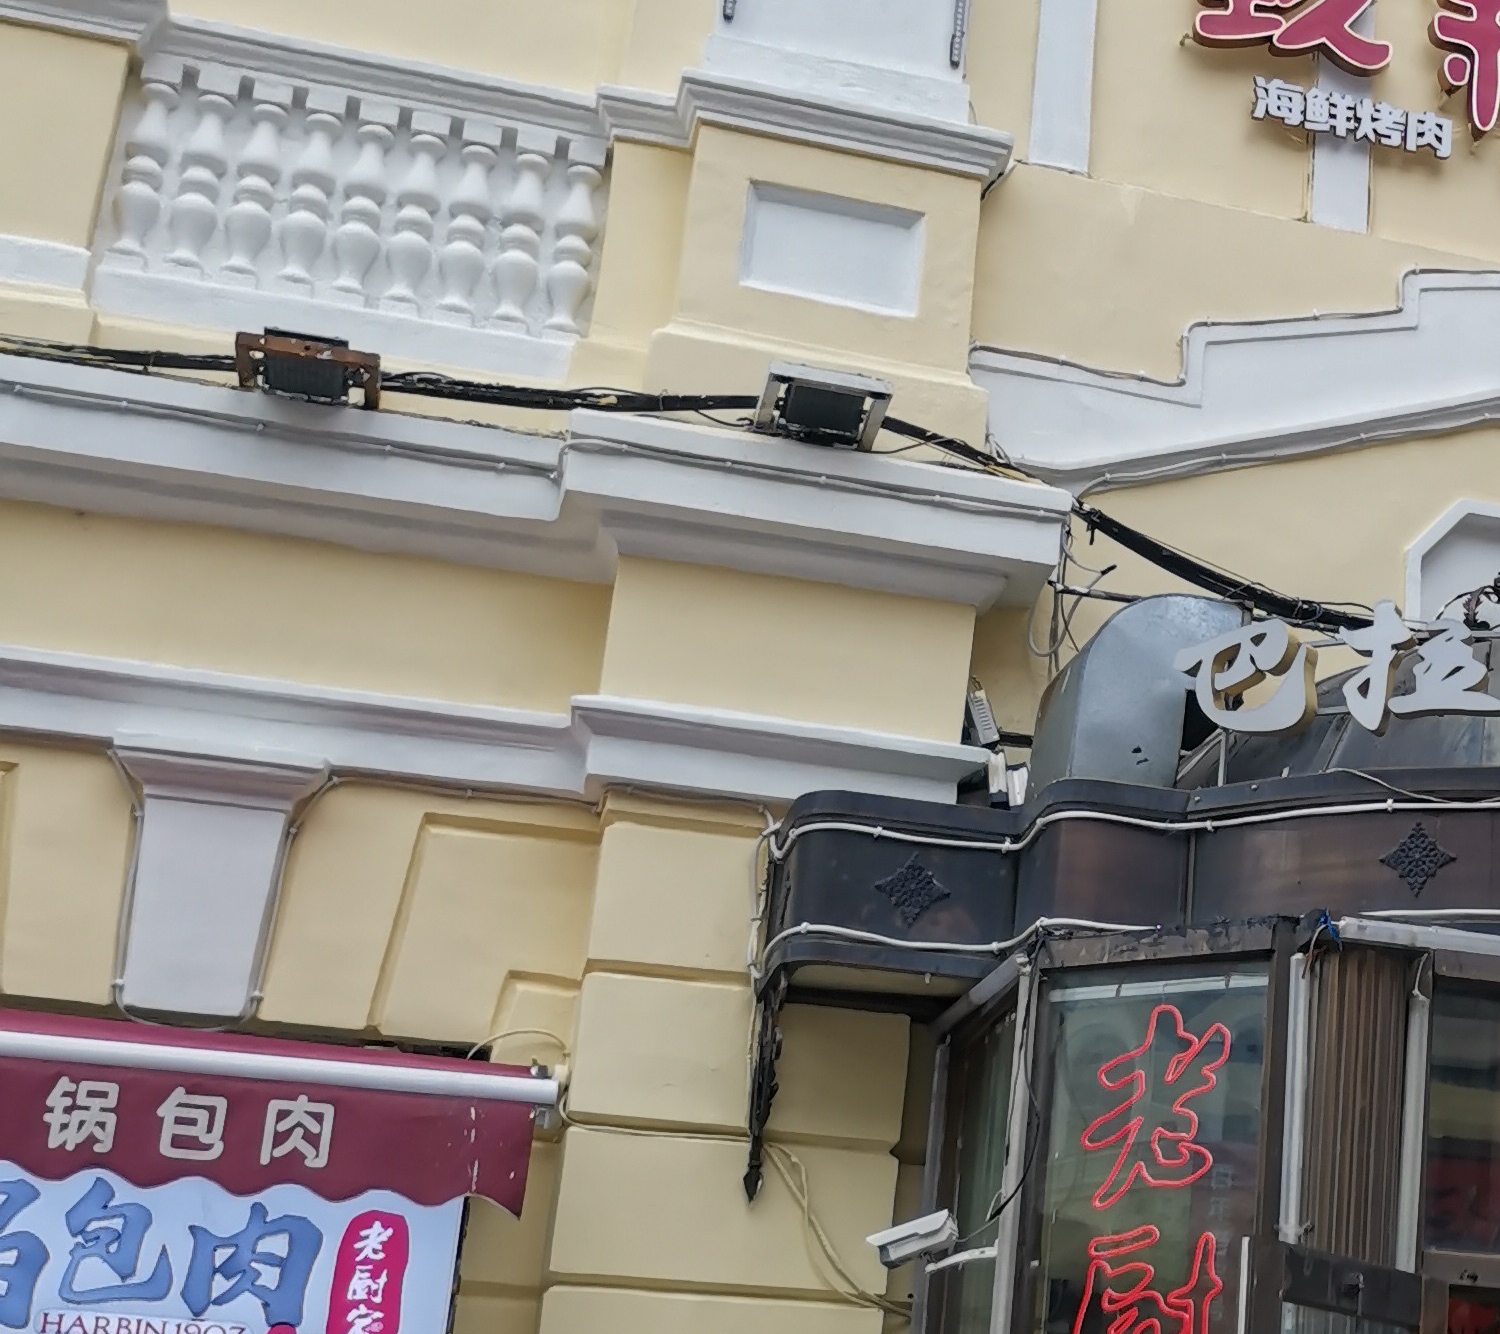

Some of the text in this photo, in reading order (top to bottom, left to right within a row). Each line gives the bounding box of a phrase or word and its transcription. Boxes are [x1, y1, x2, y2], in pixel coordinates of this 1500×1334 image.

[1252, 75, 1454, 160] 海鲜烤肉
[42, 1075, 336, 1169] 锅包肉
